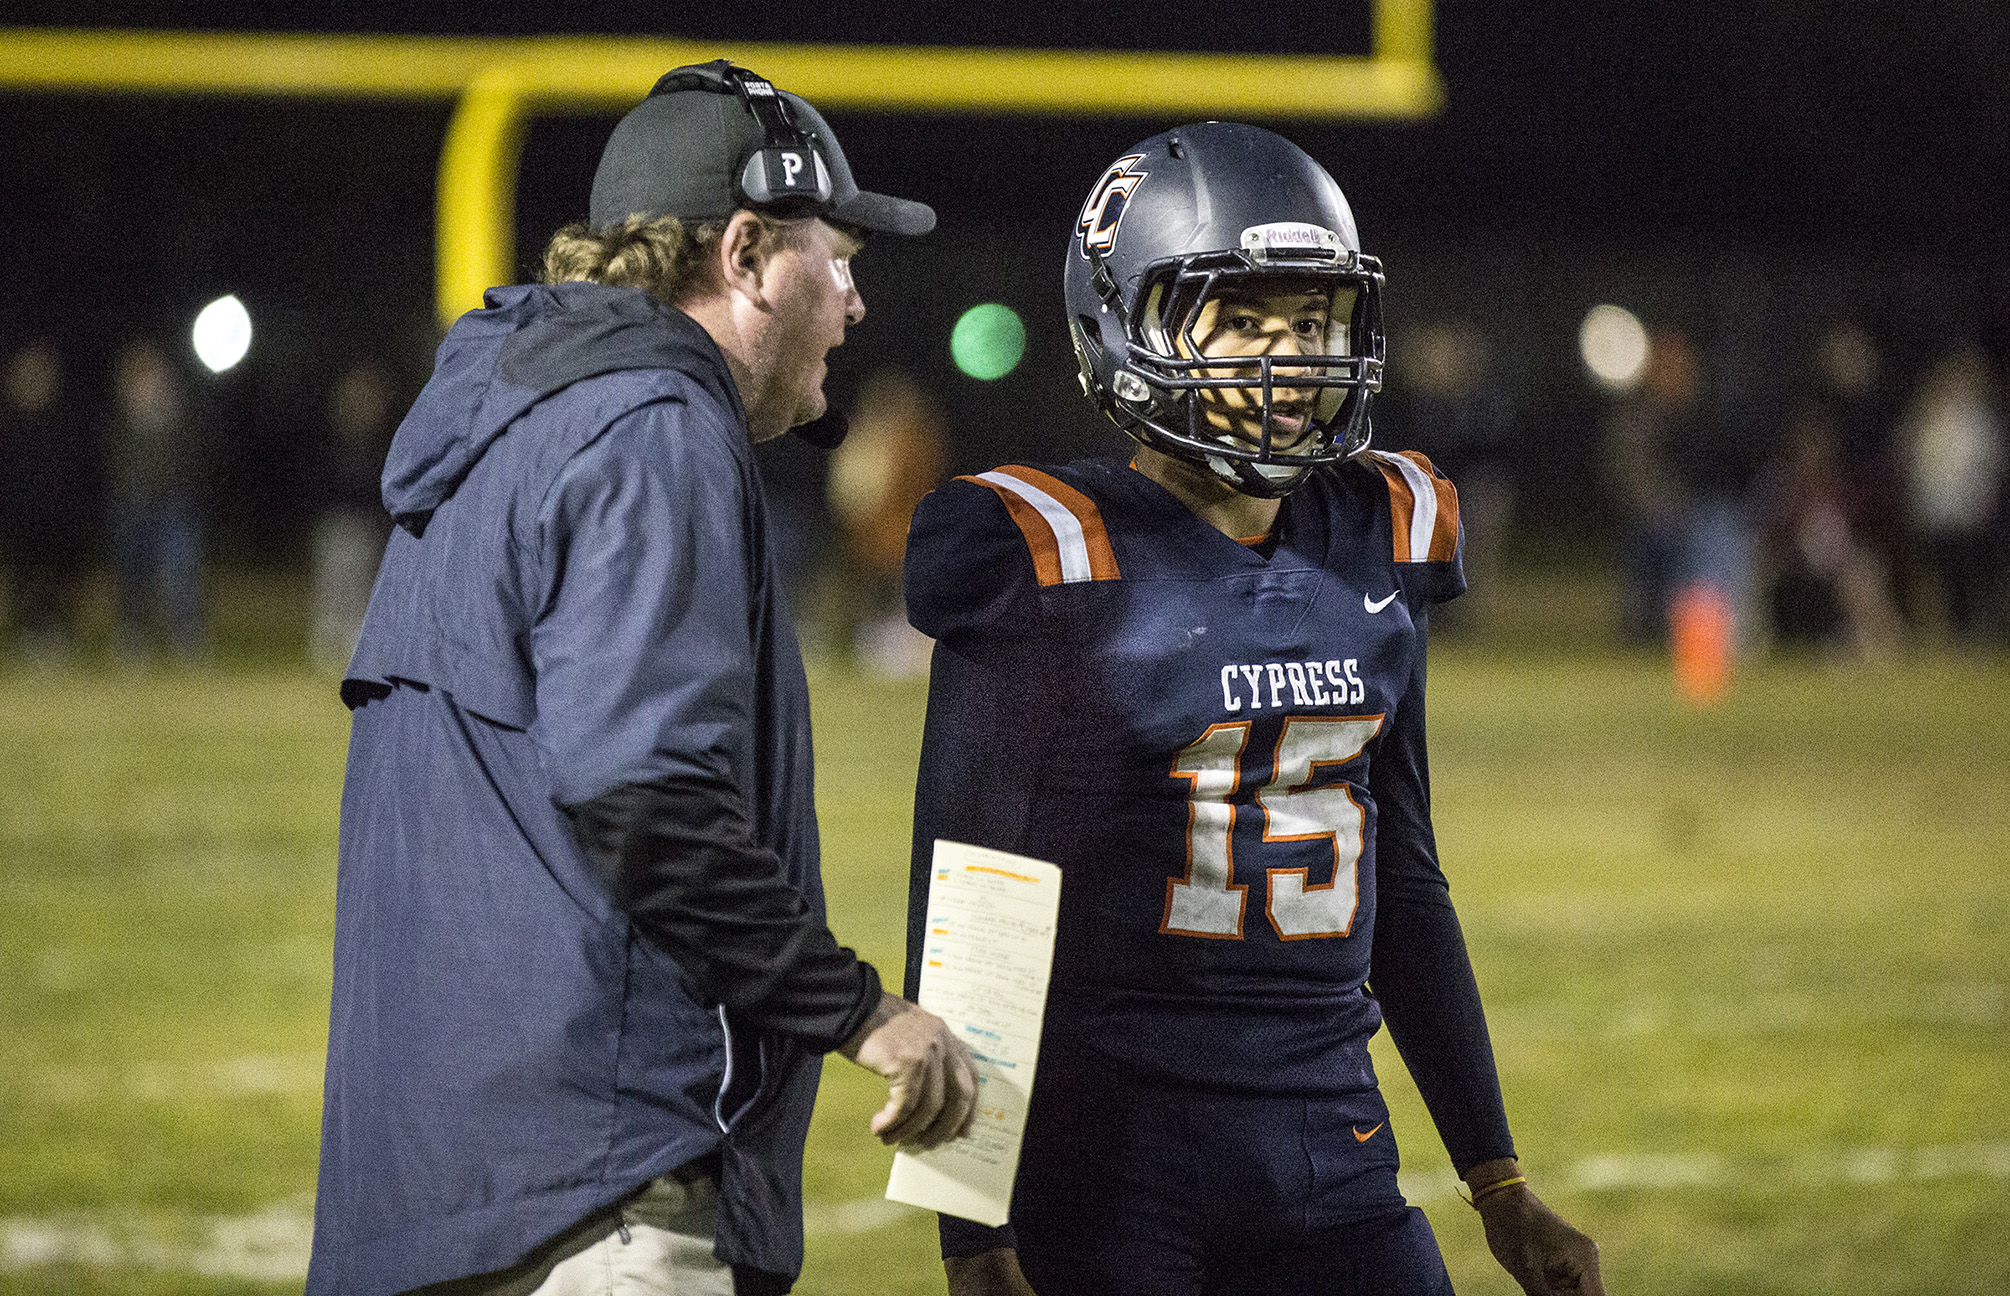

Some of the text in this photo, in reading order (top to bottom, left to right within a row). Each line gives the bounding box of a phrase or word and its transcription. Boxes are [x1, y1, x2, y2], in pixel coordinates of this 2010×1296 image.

[781, 152, 803, 186] P
[1266, 228, 1320, 243] Riddell
[1220, 658, 1365, 711] CYPRESS
[1158, 713, 1386, 942] 15
